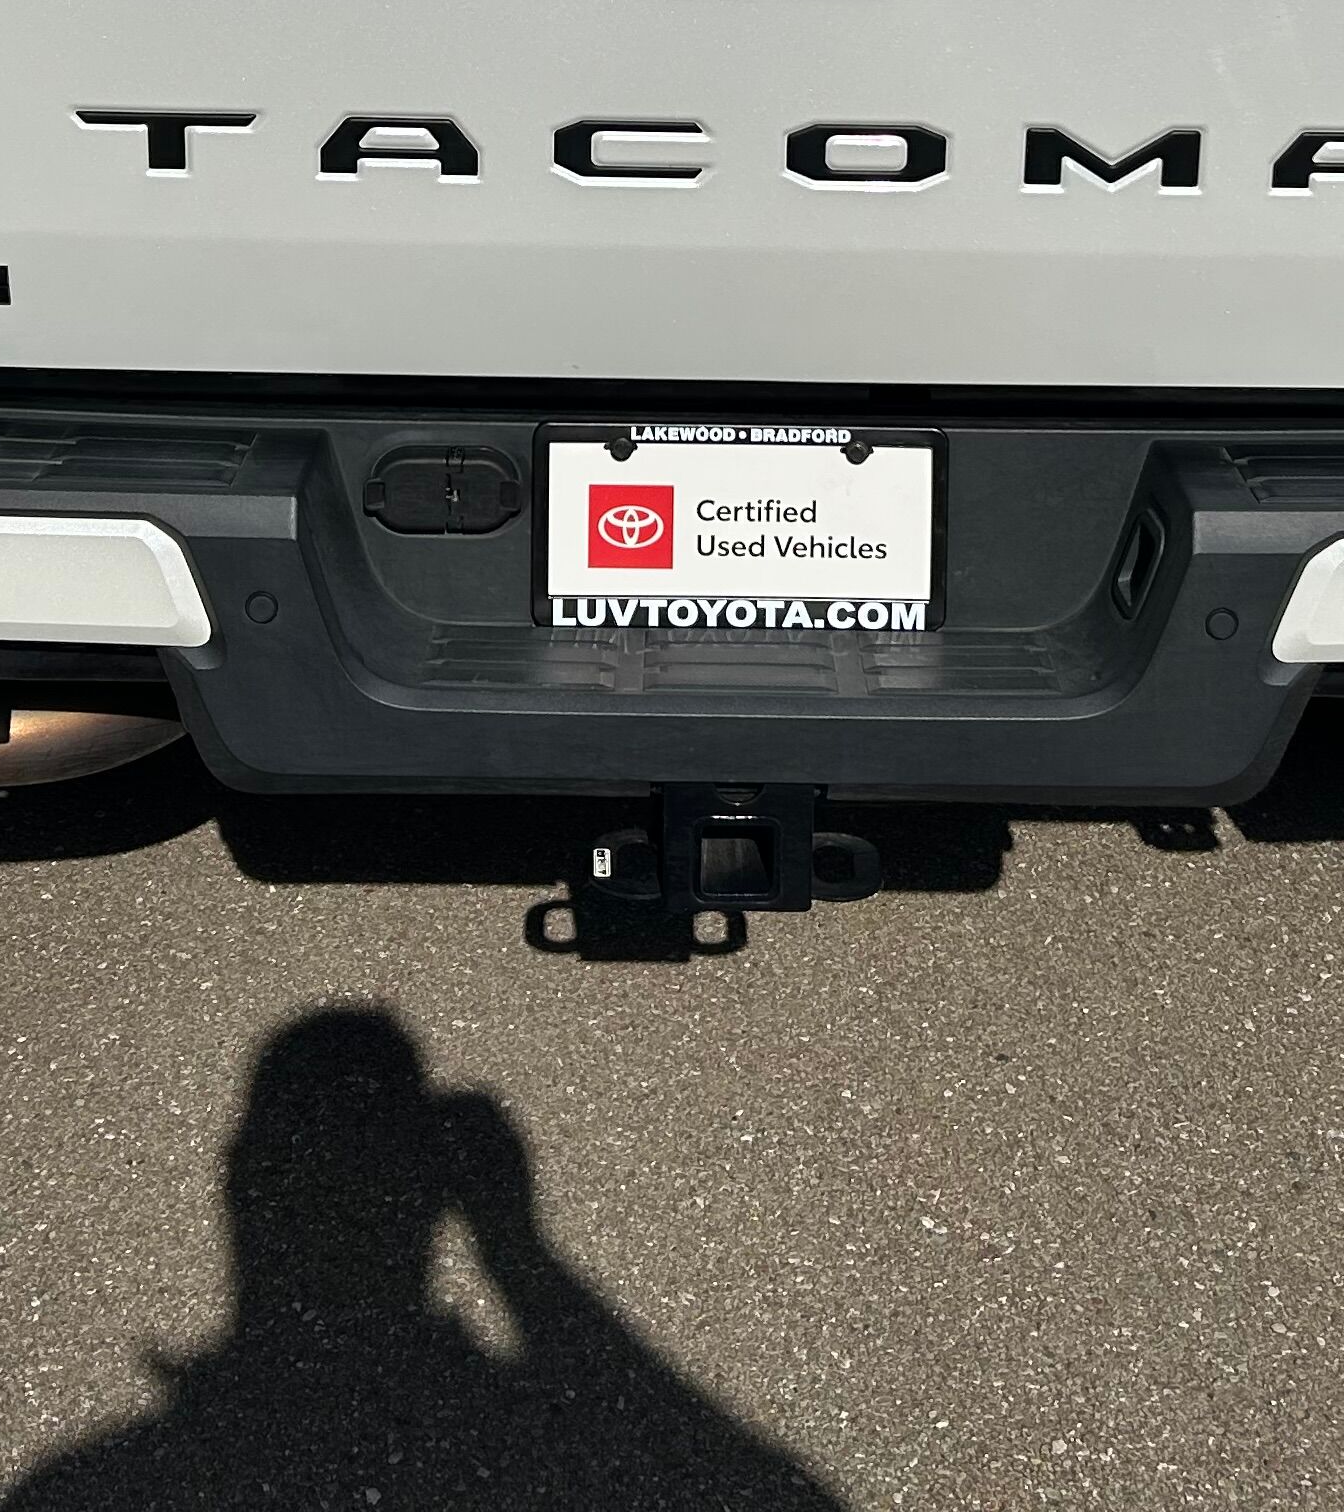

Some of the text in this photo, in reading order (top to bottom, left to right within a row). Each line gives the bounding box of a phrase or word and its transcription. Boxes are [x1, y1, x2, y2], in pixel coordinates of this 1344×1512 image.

[631, 425, 852, 445] LAKEWOOD BRADFORD
[696, 499, 817, 523] Certified
[696, 535, 888, 560] Used Vehicles
[552, 598, 926, 631] LUVTOYOTA.COM
